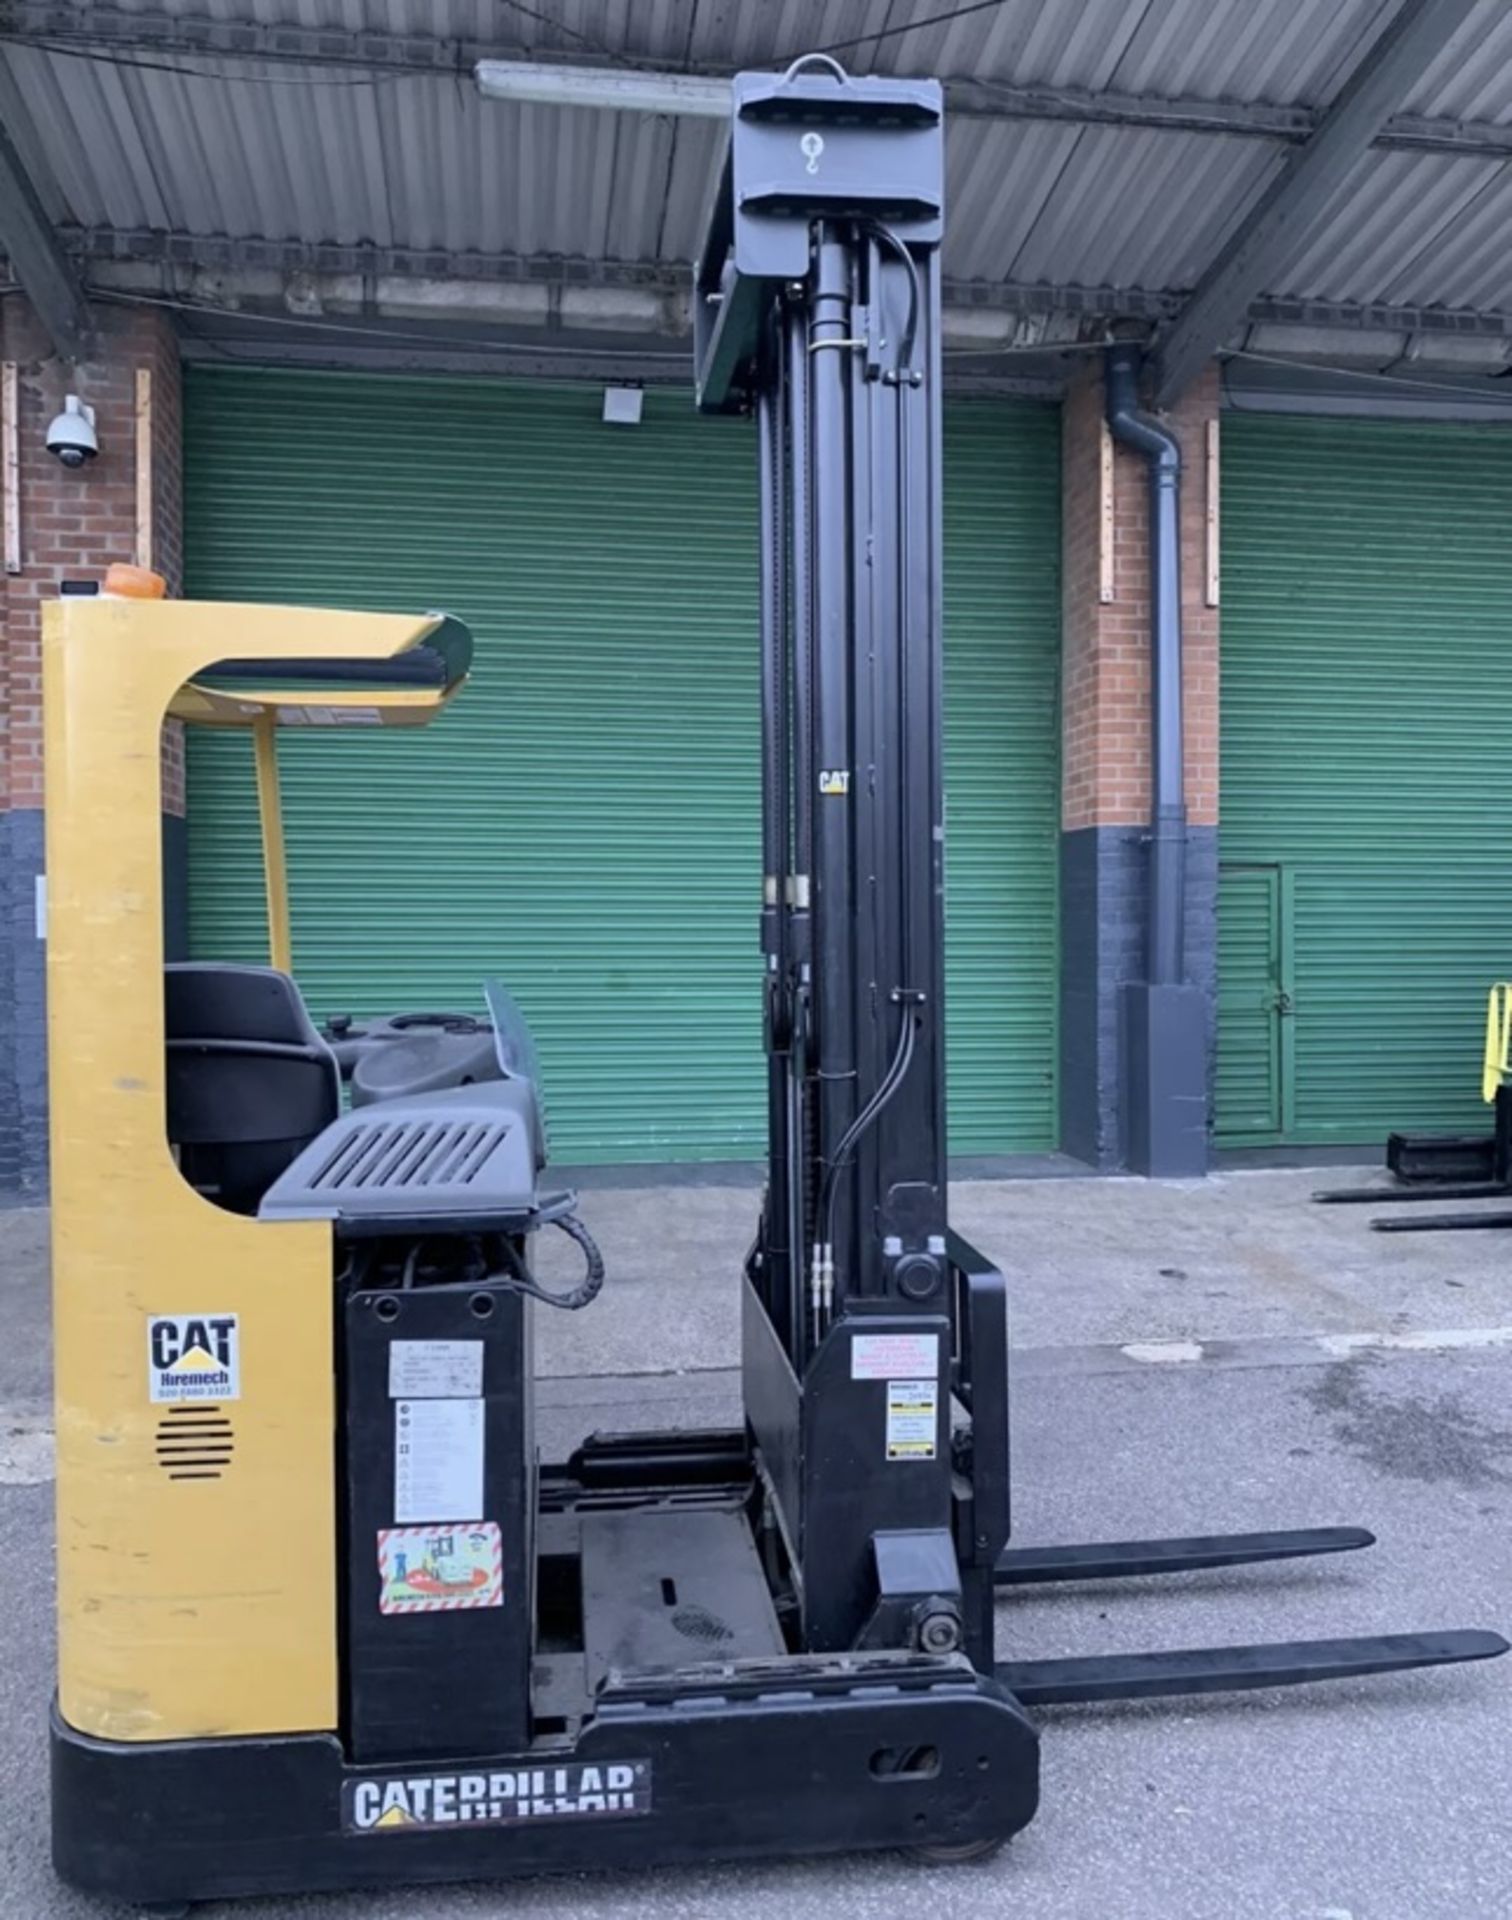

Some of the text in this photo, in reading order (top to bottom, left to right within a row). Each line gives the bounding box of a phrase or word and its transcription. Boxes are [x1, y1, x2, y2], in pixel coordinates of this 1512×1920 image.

[819, 771, 850, 792] CAT
[151, 1319, 235, 1370] CAT
[161, 1370, 229, 1387] Hiremech
[353, 1764, 635, 1829] CATERPILLAR
